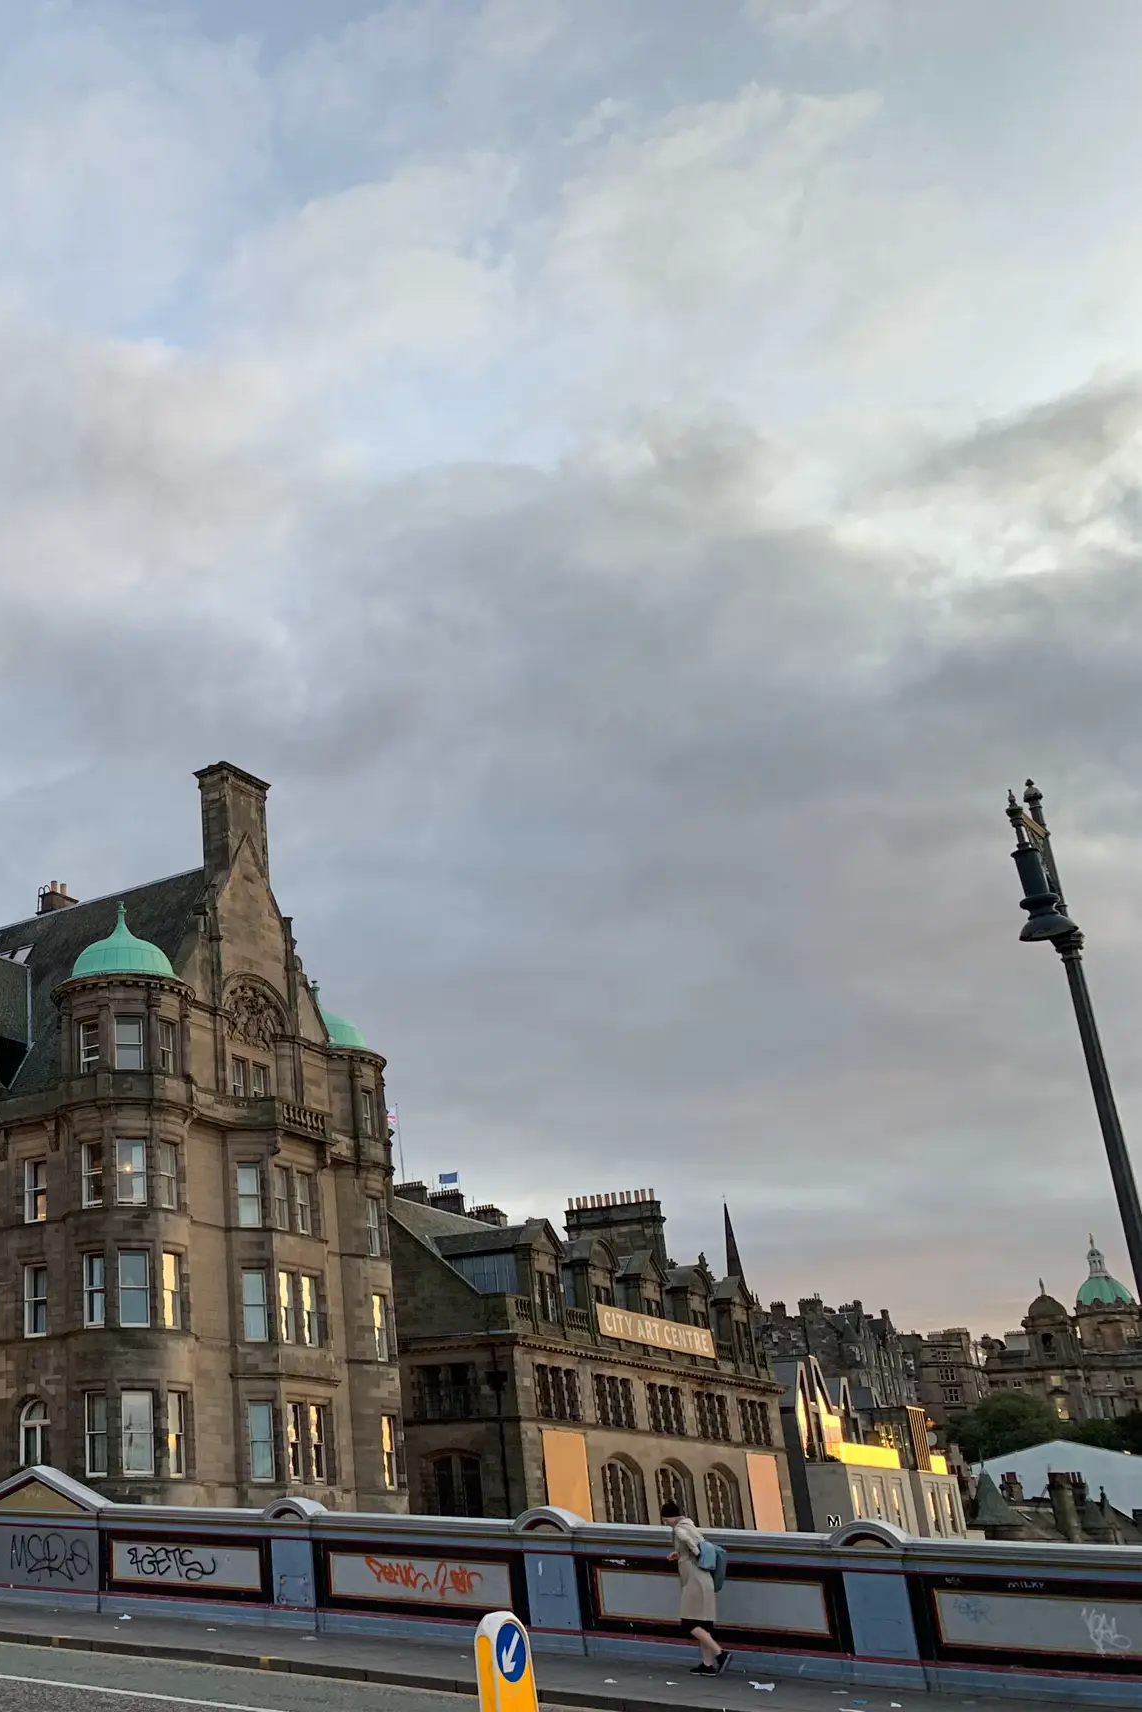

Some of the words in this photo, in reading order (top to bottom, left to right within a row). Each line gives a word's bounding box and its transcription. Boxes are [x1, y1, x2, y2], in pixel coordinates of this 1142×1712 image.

[603, 1311, 633, 1337] CITY
[637, 1320, 660, 1344] ART
[663, 1325, 710, 1353] CENTRE
[826, 1514, 842, 1528] M
